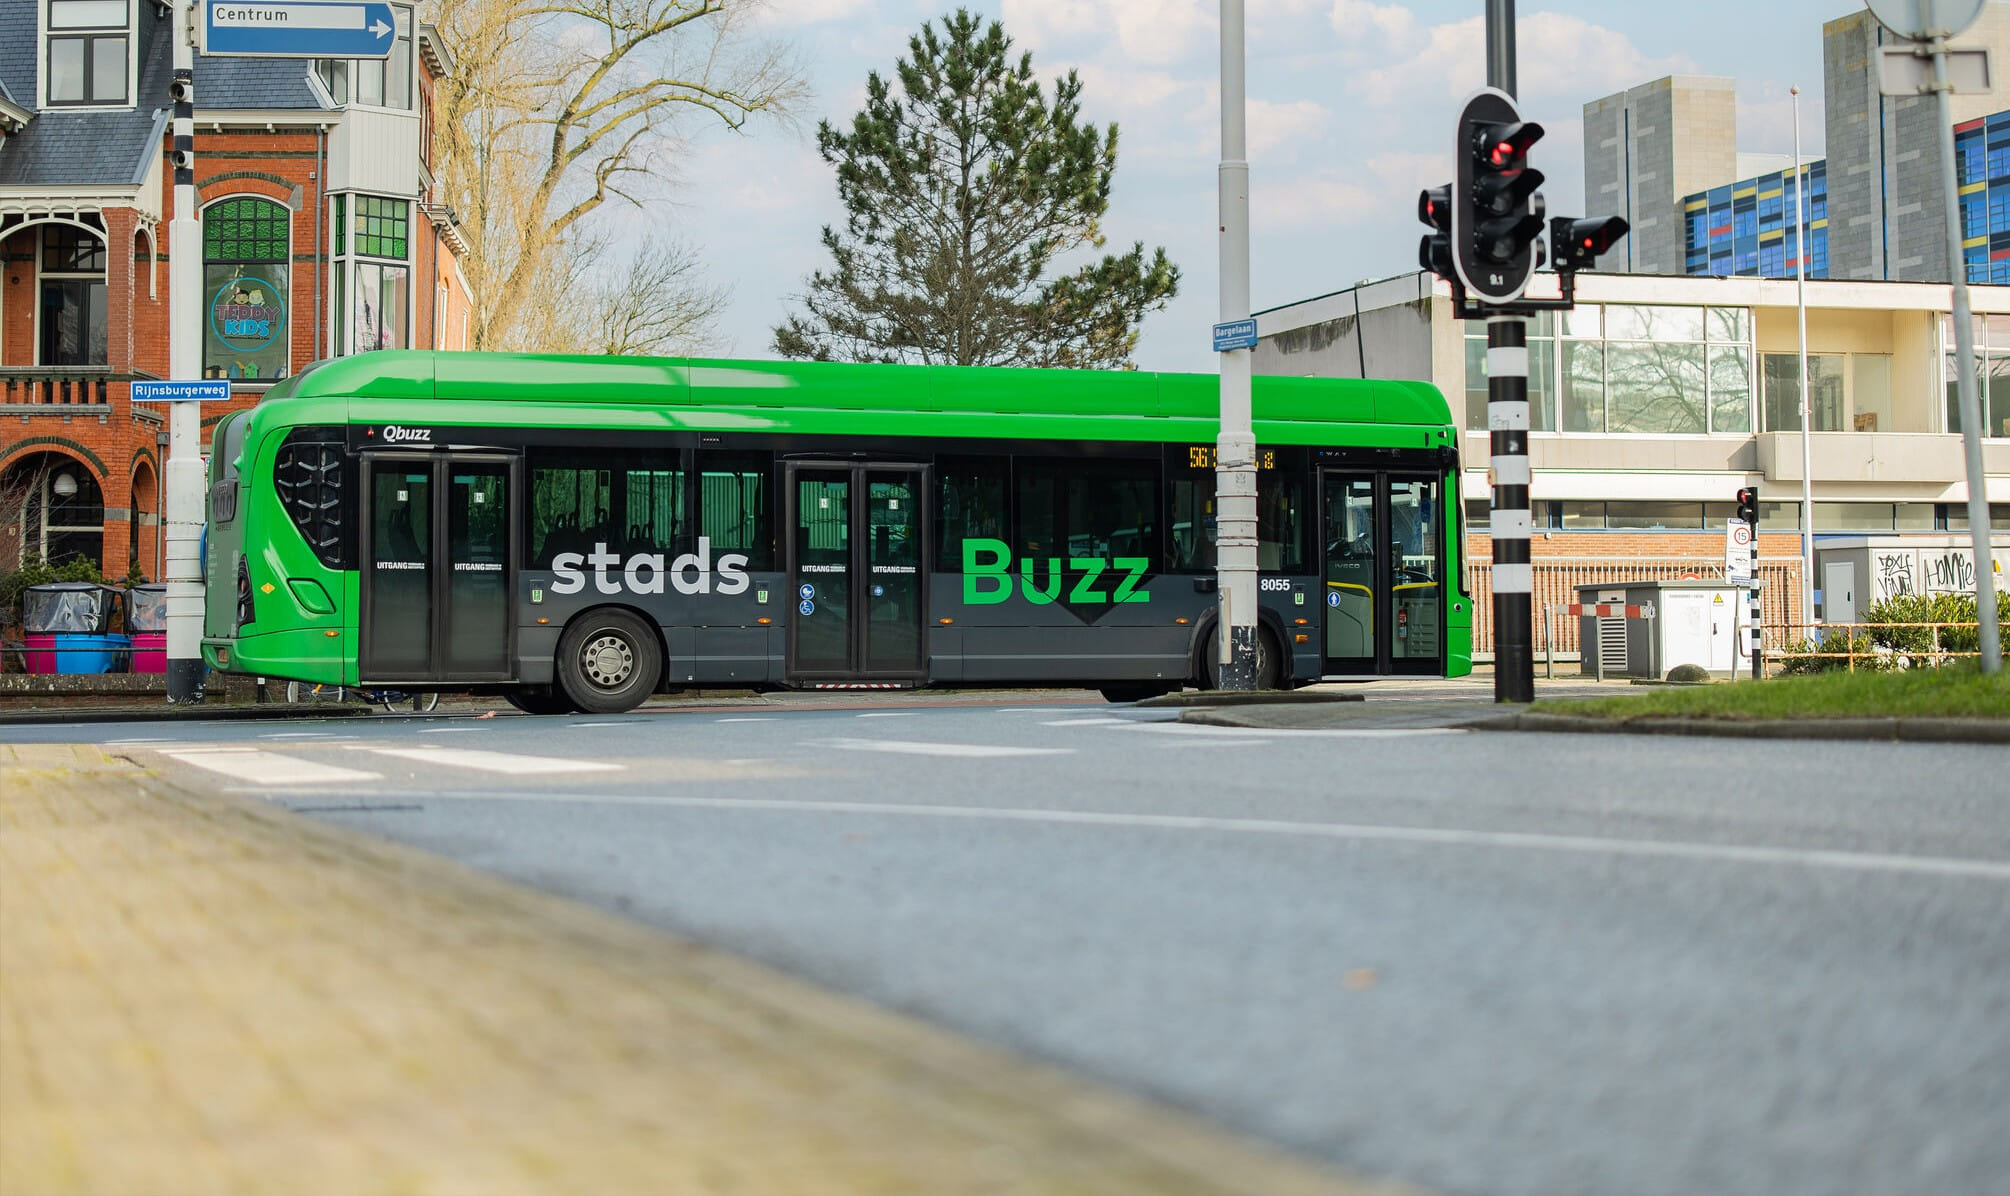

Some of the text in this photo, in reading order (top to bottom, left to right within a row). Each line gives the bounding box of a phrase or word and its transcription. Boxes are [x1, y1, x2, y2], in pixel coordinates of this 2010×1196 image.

[216, 7, 288, 21] Centrum
[216, 304, 281, 323] TEDDY
[224, 319, 270, 337] KIDS
[1215, 325, 1252, 338] Bargelaan
[135, 385, 226, 398] Rijnsburgerweg
[383, 425, 431, 443] Qbuzz
[1190, 446, 1208, 469] 56
[1738, 532, 1747, 541] 15
[376, 561, 408, 570] UITGANG
[454, 563, 485, 571] UITGANG
[550, 536, 750, 595] stads
[802, 565, 830, 573] UITGANG
[872, 566, 901, 574] UITGANG
[962, 538, 1150, 605] Buzz
[1261, 578, 1291, 591] 8055
